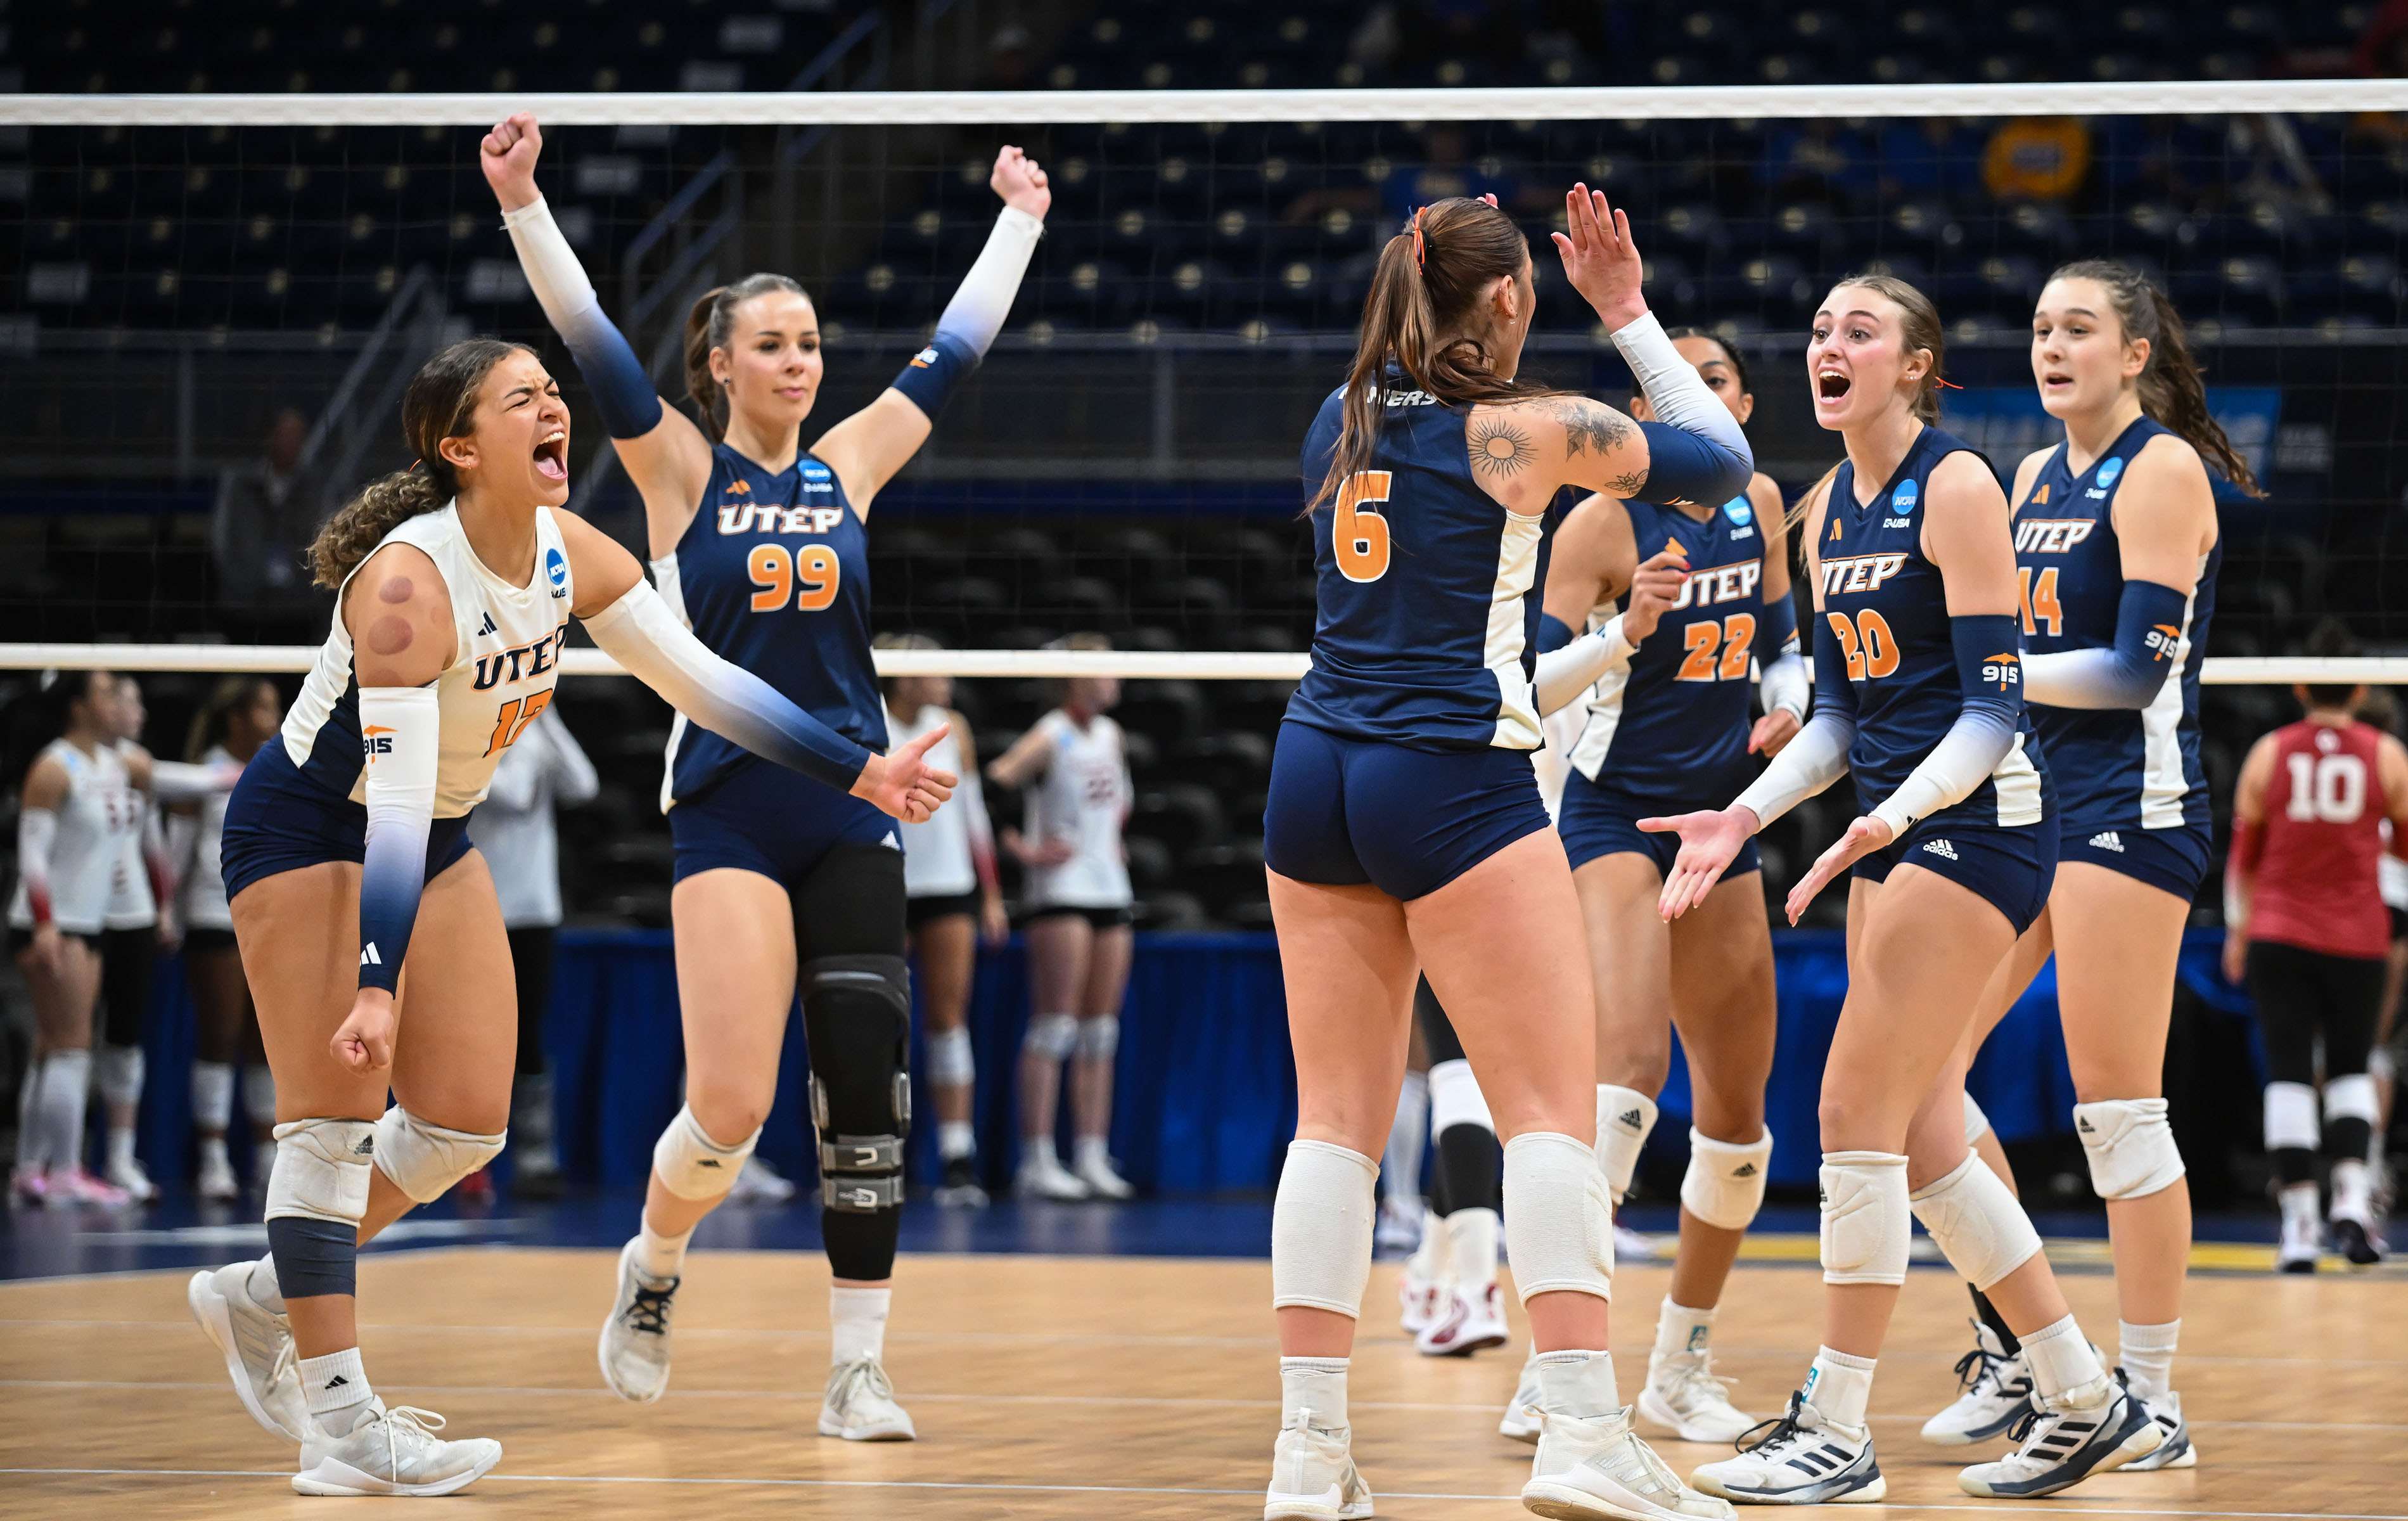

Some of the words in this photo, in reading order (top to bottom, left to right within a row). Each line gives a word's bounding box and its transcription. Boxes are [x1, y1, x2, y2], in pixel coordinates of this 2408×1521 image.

[1338, 386, 1438, 407] NERS
[717, 502, 843, 535] UTEP
[1332, 470, 1393, 583] 6
[2014, 518, 2097, 554] UTEP
[747, 542, 840, 613] 99
[2017, 566, 2063, 637] 14
[470, 620, 572, 693] UTEP
[1673, 612, 1757, 683] 22
[1826, 608, 1900, 682] 20
[2144, 631, 2177, 659] 915
[1982, 665, 2018, 684] 915
[364, 737, 392, 755] 915
[2285, 751, 2368, 824] 10
[1923, 844, 1959, 861] adidas
